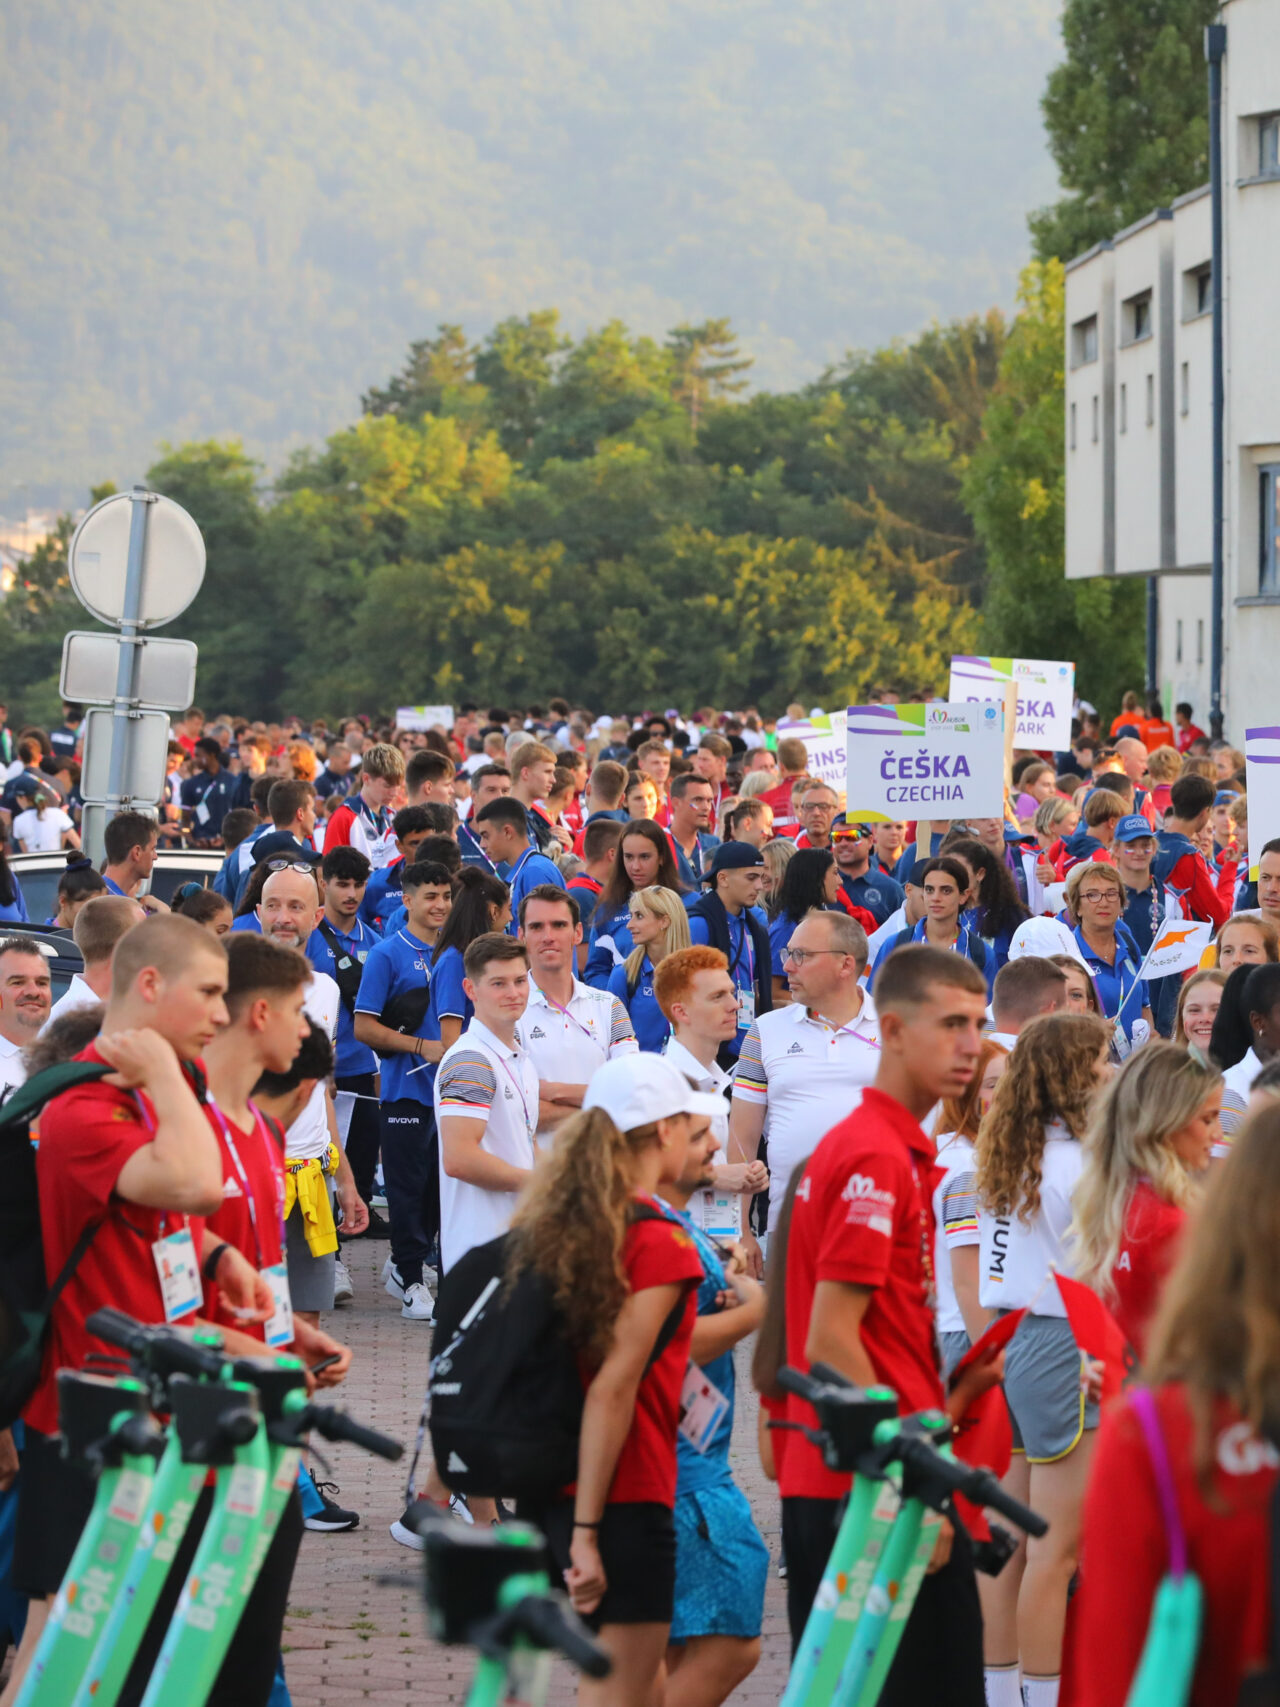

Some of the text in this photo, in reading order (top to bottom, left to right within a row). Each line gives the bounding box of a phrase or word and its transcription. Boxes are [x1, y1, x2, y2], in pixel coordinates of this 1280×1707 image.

[806, 747, 847, 770] FINS
[880, 749, 971, 780] ČEŠKA
[886, 785, 964, 802] CZECHIA
[62, 1567, 115, 1639] Bolt
[185, 1562, 235, 1632] Bolt
